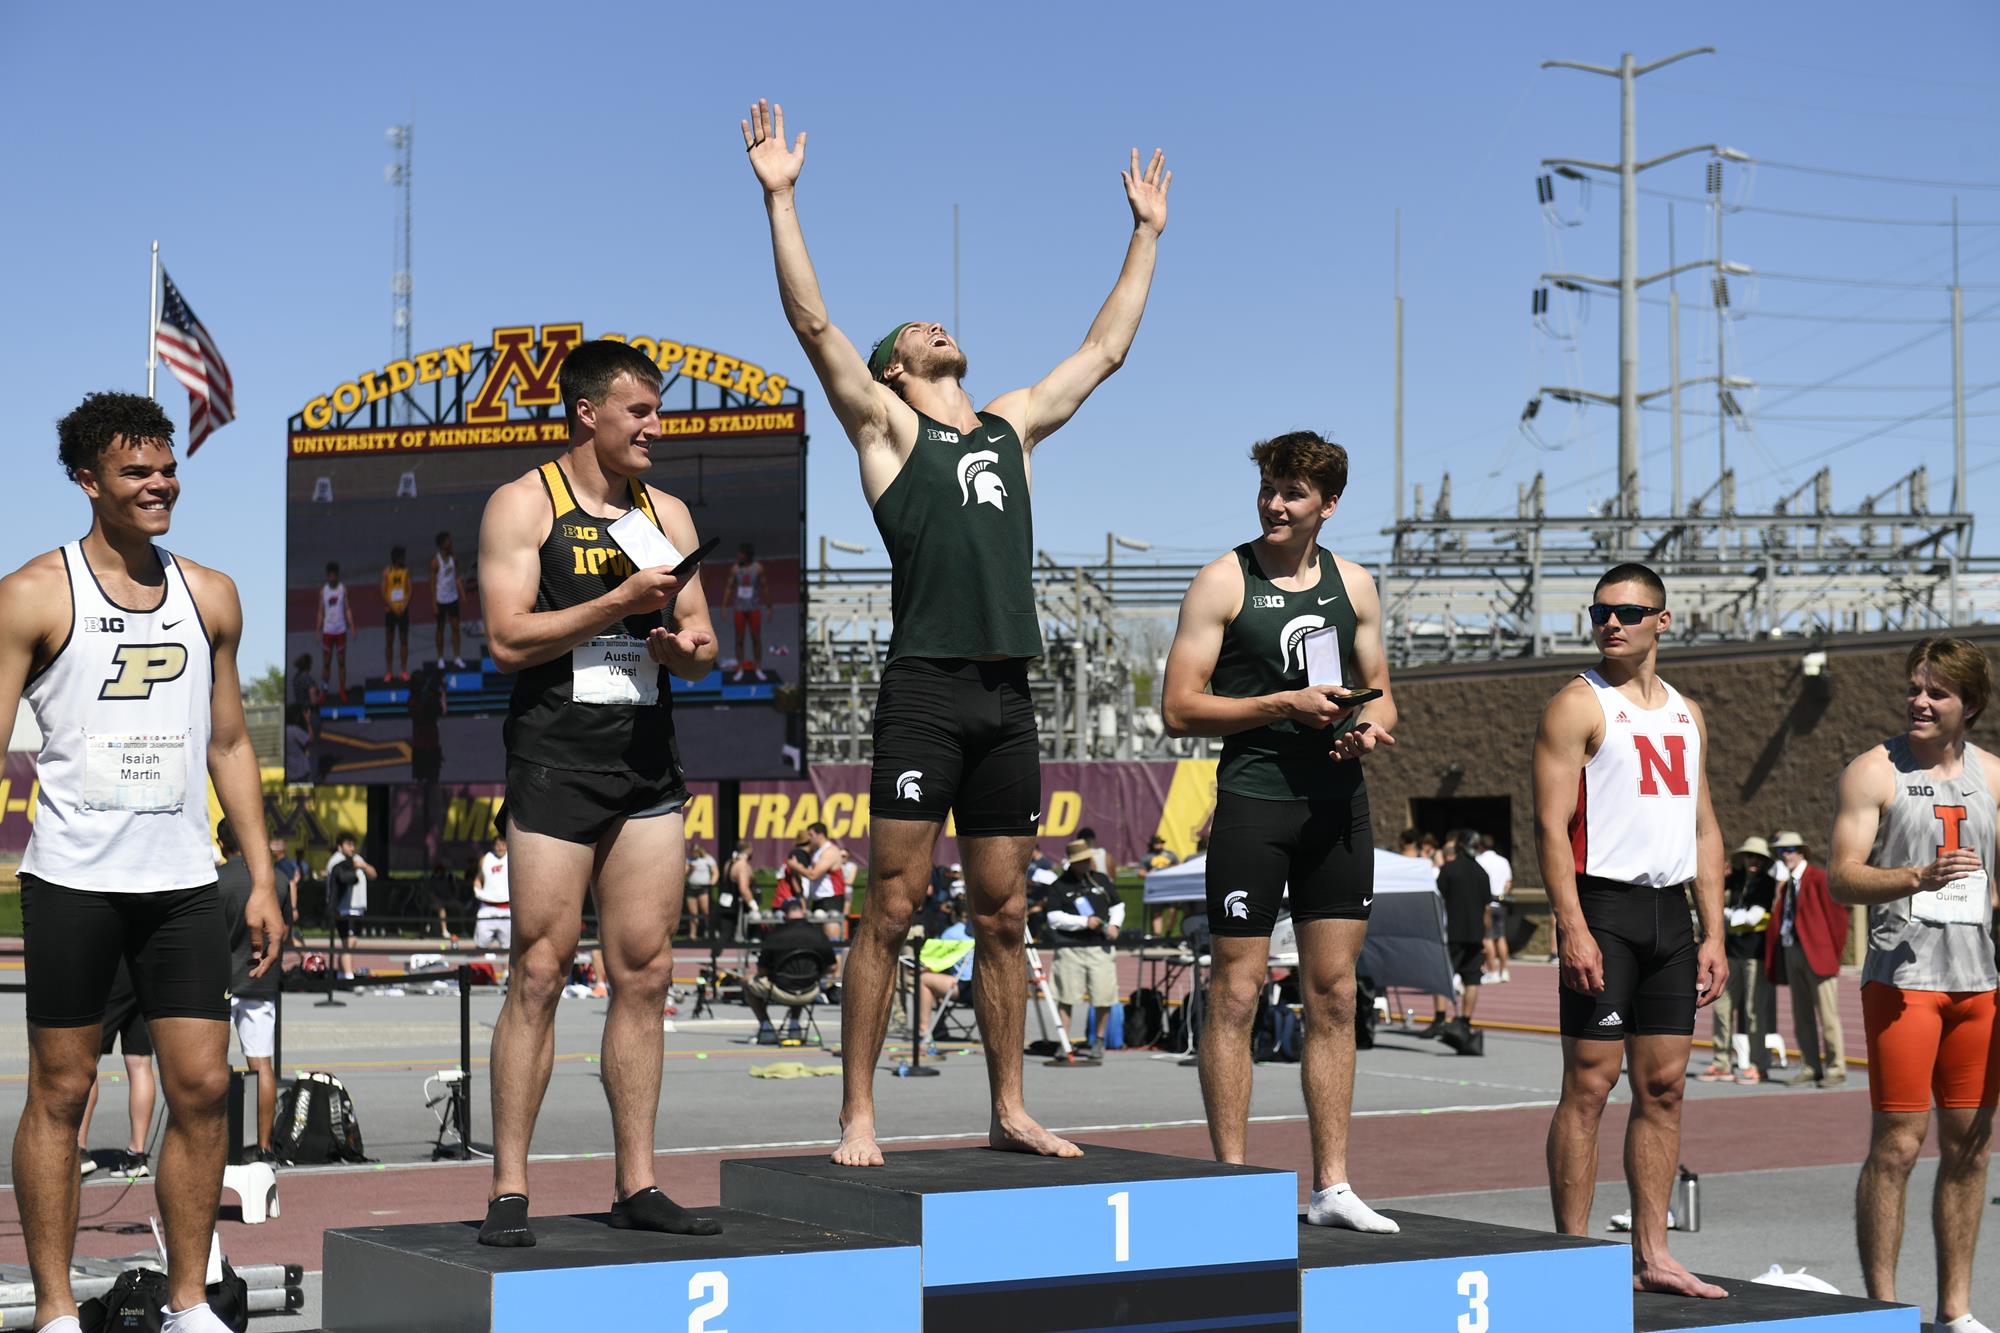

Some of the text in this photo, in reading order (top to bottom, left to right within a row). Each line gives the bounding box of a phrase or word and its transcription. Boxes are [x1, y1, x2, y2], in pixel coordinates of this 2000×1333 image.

[303, 342, 473, 429] GOLDEN
[600, 332, 788, 406] OPHERS
[292, 432, 398, 453] UNIVERSITY
[401, 430, 426, 448] OF
[429, 425, 537, 446] MINNESOTA
[660, 412, 795, 435] IELD STADIUM
[97, 643, 188, 700] P
[604, 651, 640, 662] Austin
[609, 666, 637, 676] West
[120, 768, 161, 780] Martin
[122, 753, 160, 764] Isaiah
[1631, 732, 1691, 798] N
[1107, 1191, 1130, 1262] 1
[688, 1270, 728, 1333] 2
[1457, 1270, 1489, 1333] 3
